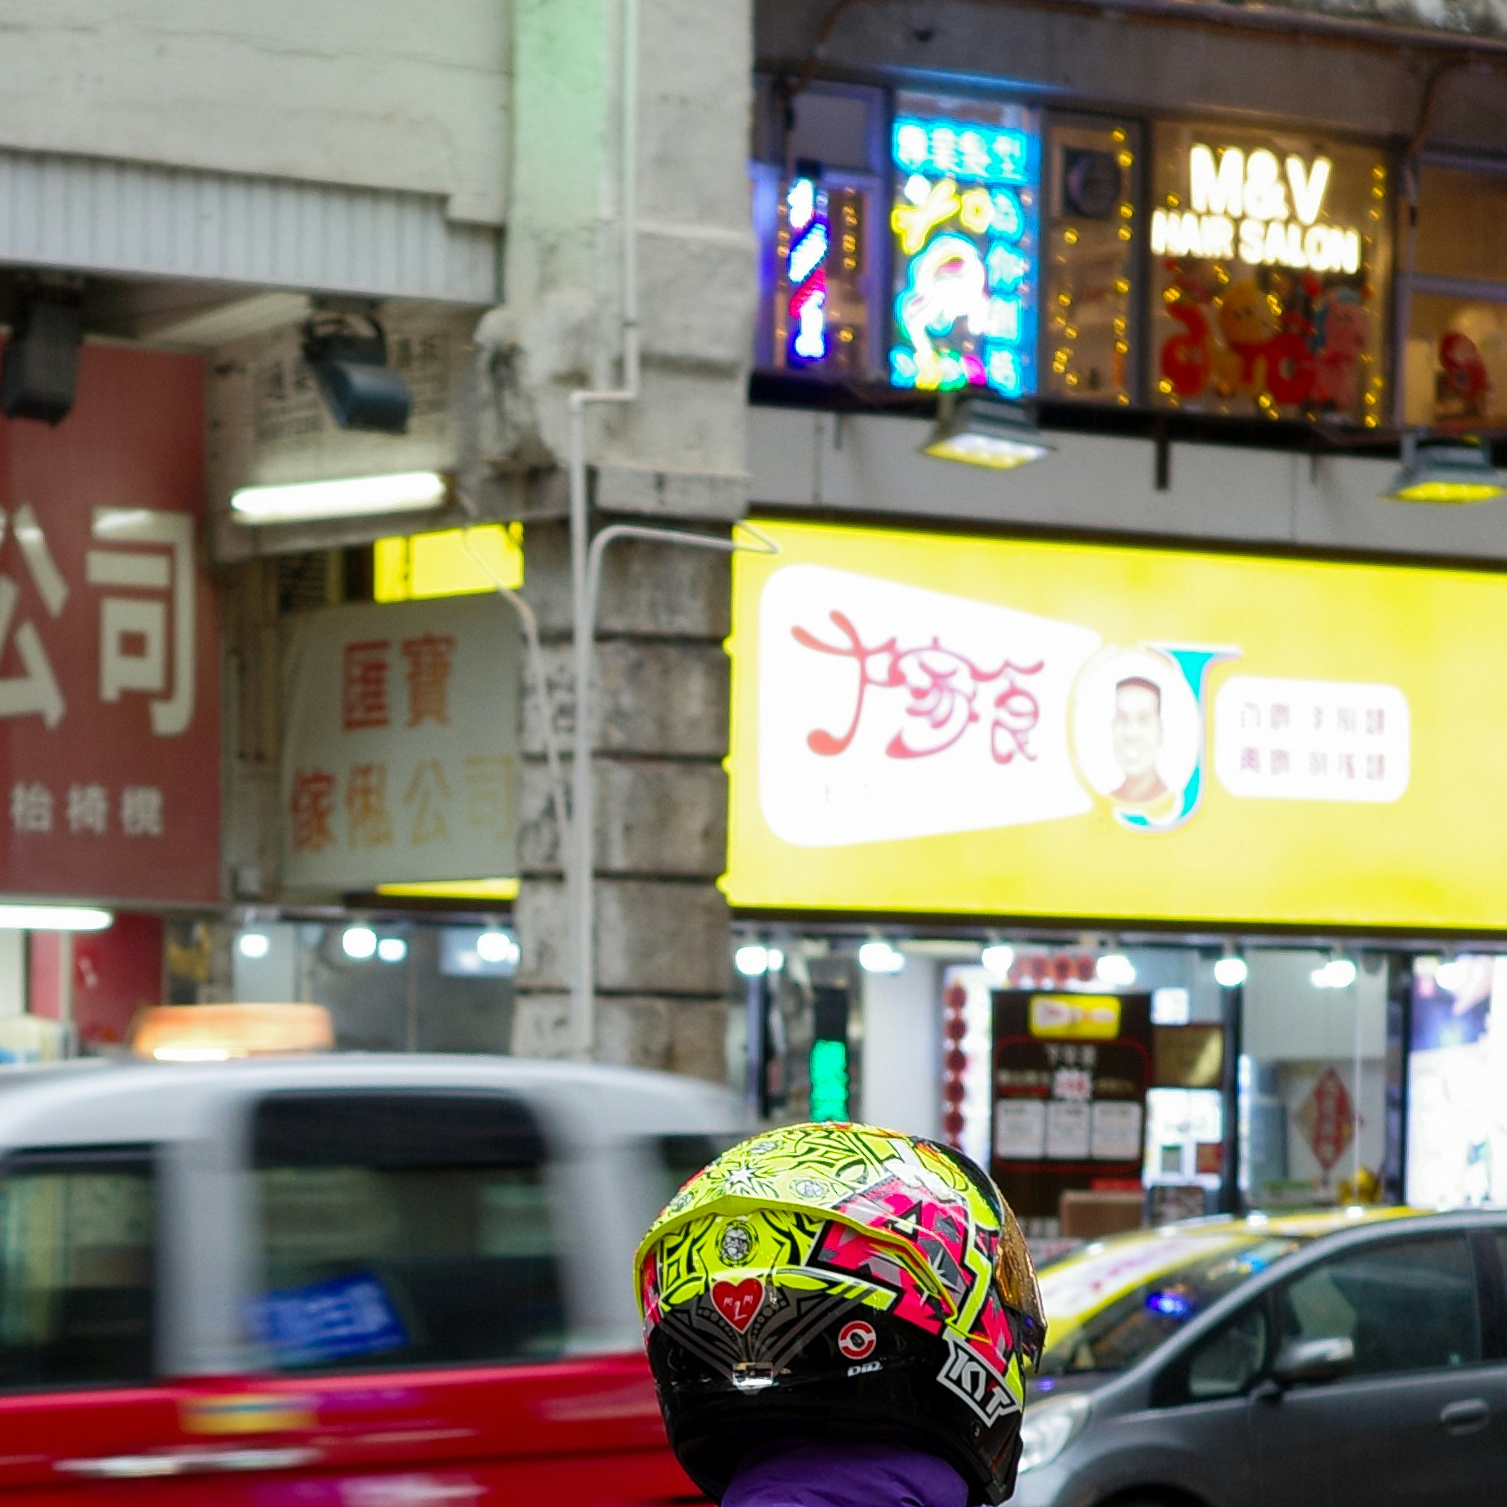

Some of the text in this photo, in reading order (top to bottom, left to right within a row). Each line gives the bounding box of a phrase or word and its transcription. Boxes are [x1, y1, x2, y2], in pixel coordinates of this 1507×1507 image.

[1188, 141, 1331, 227] M&V
[1150, 206, 1362, 275] HAIR SALON
[341, 633, 457, 731] 匯寶
[947, 1347, 1013, 1418] KYT
